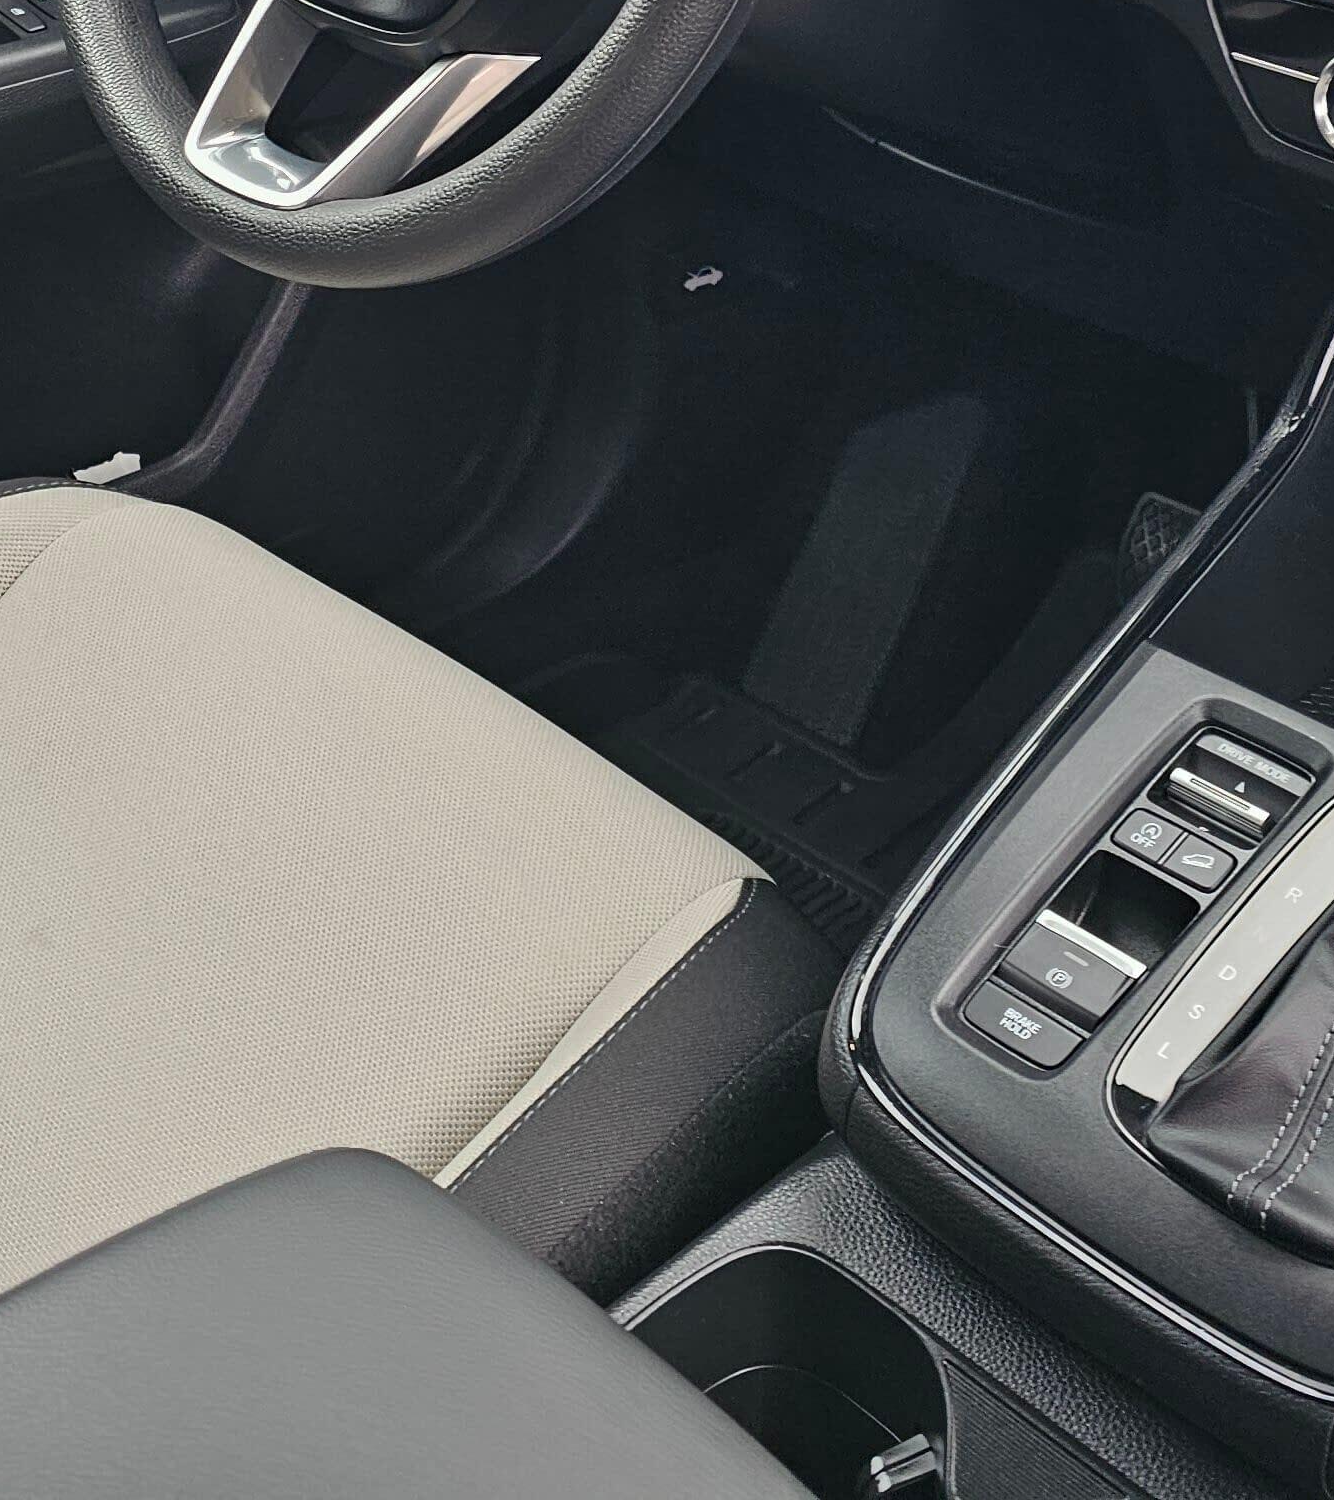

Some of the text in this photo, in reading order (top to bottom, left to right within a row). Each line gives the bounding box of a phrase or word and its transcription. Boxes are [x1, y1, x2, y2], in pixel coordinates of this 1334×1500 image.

[1218, 743, 1292, 783] DRIVE MODE
[1130, 832, 1156, 848] OFF
[1284, 887, 1304, 903] R
[1217, 964, 1238, 981] D
[1187, 1003, 1206, 1020] S
[999, 1017, 1032, 1040] HOLD
[1003, 1007, 1042, 1035] BRAKE
[1157, 1041, 1171, 1059] L
